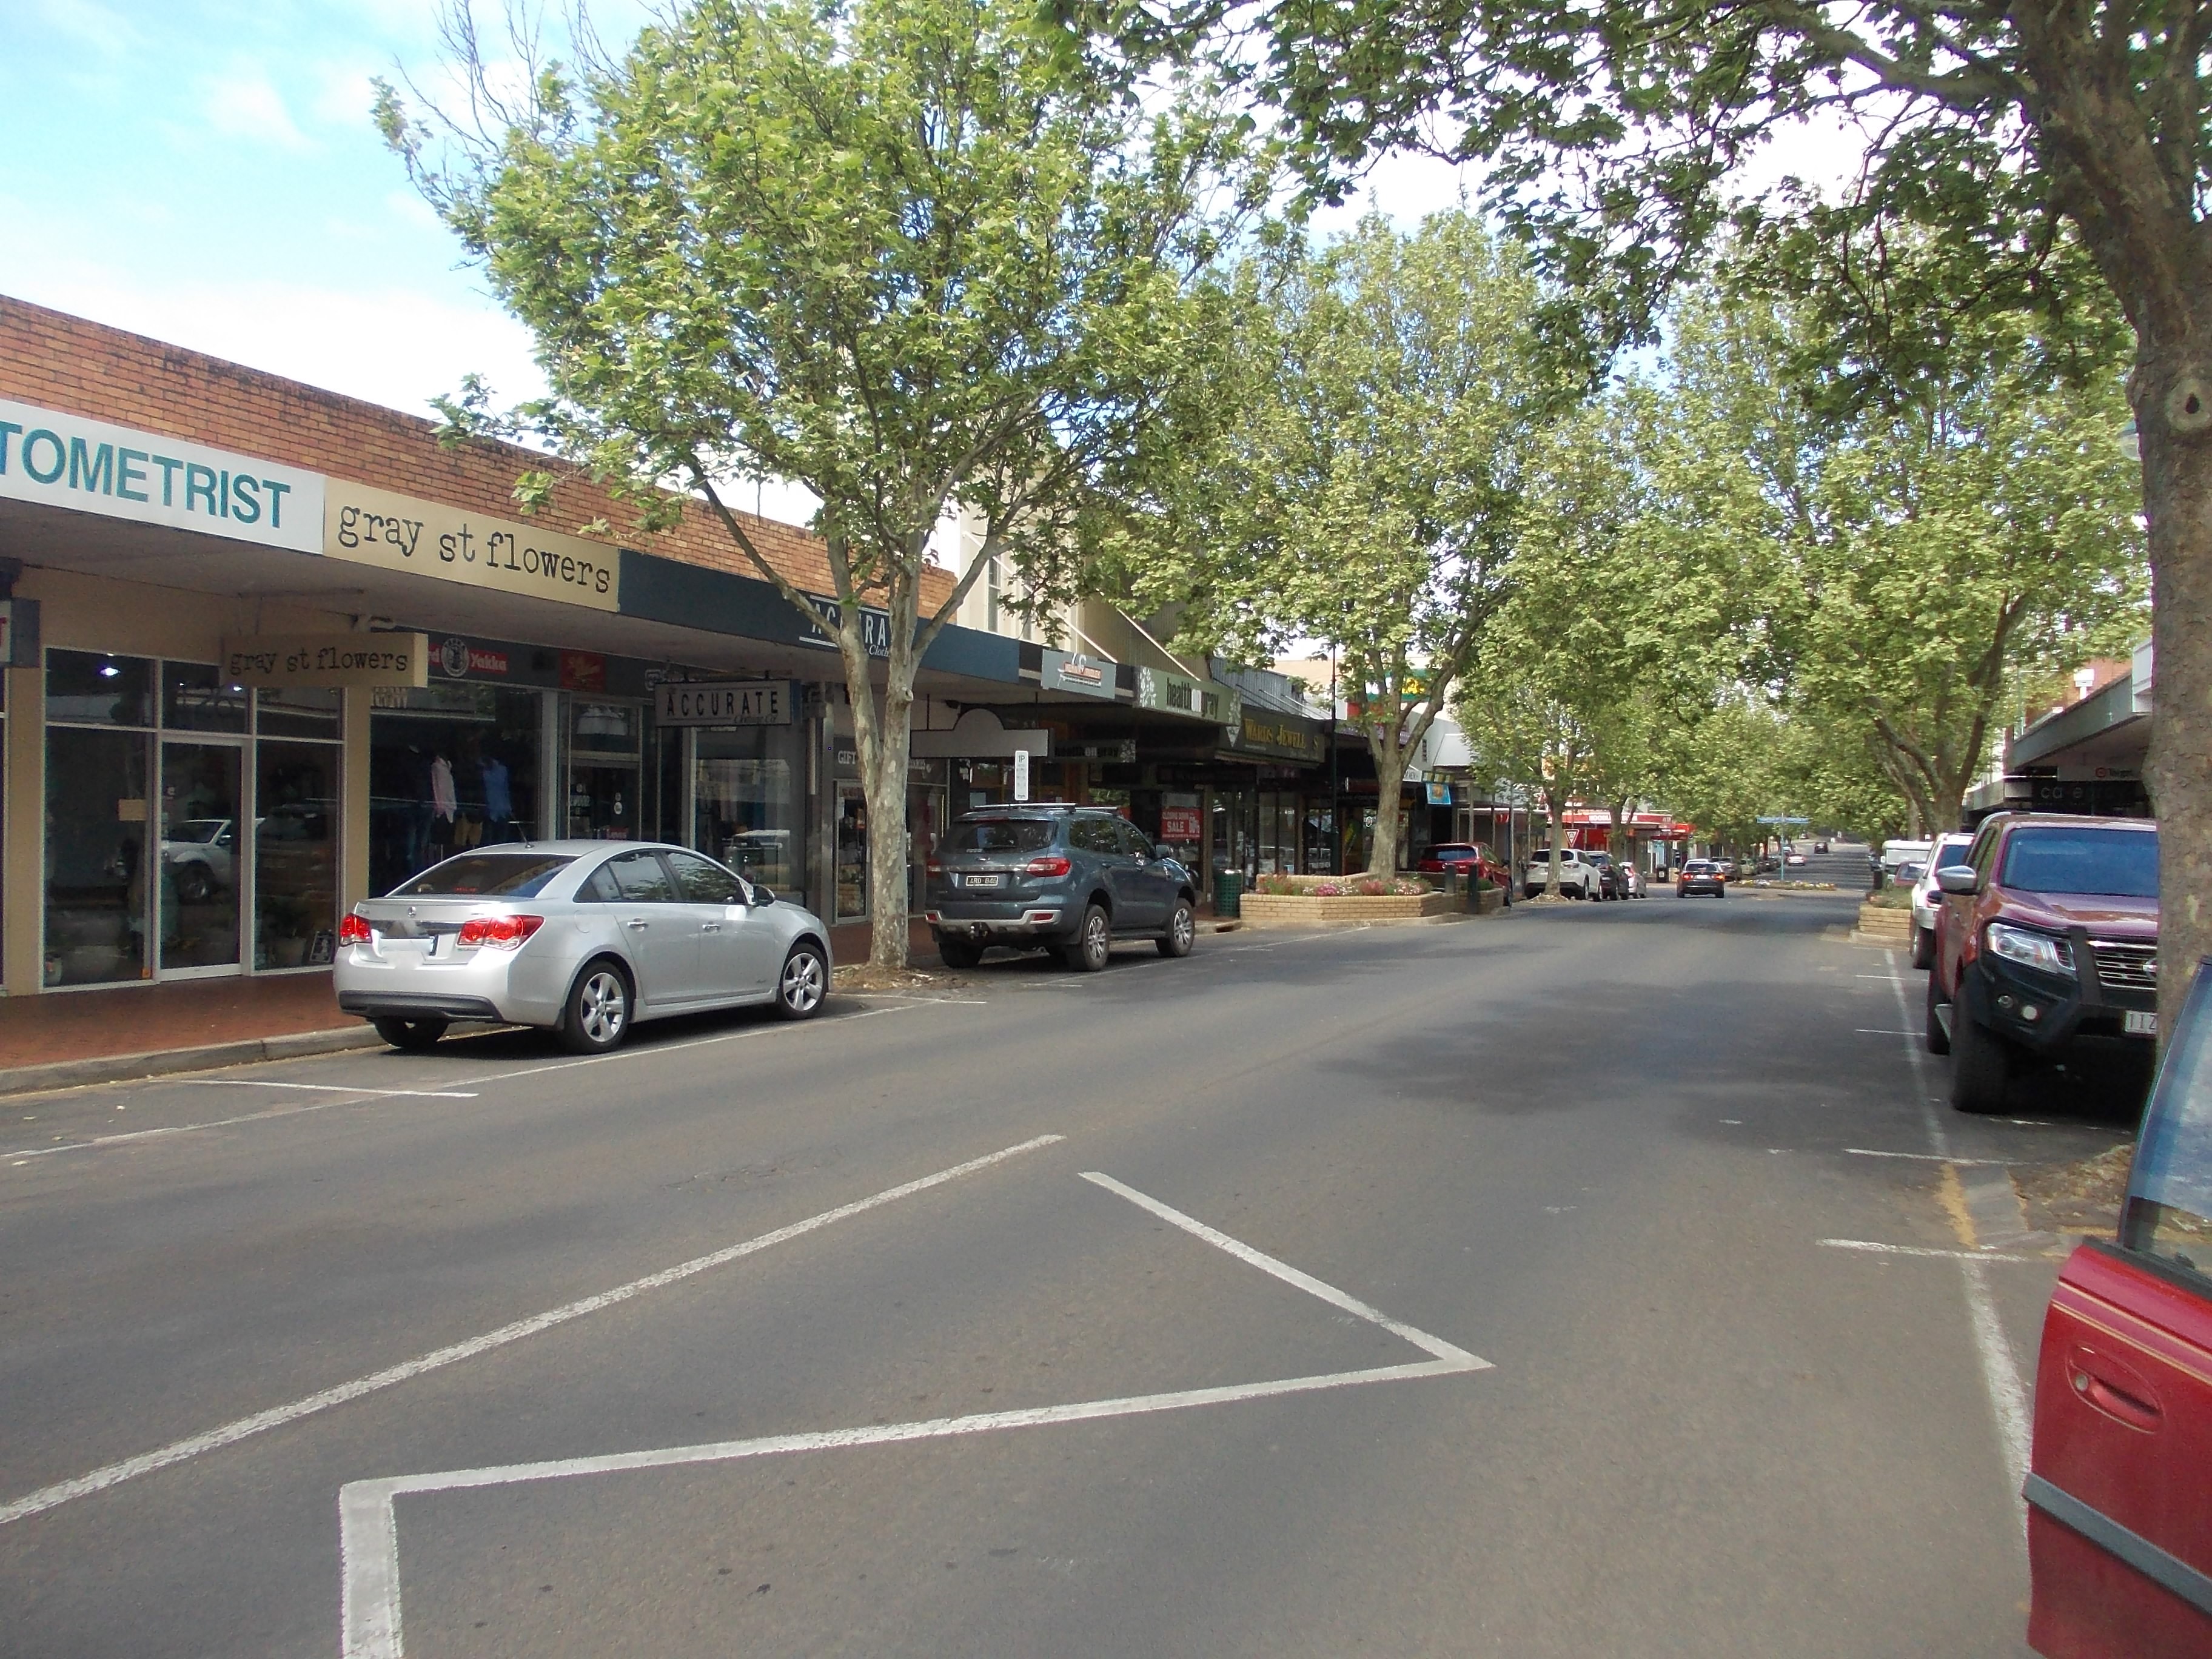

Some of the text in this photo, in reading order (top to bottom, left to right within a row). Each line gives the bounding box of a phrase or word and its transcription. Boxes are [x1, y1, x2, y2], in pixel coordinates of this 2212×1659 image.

[338, 505, 611, 594] gray st flowers
[230, 647, 407, 677] gray st flowers
[470, 652, 507, 671] Yakka
[666, 691, 779, 716] ACCURATE
[1167, 677, 1192, 710] health
[838, 750, 856, 765] GIFT
[1167, 820, 1184, 833] SALE
